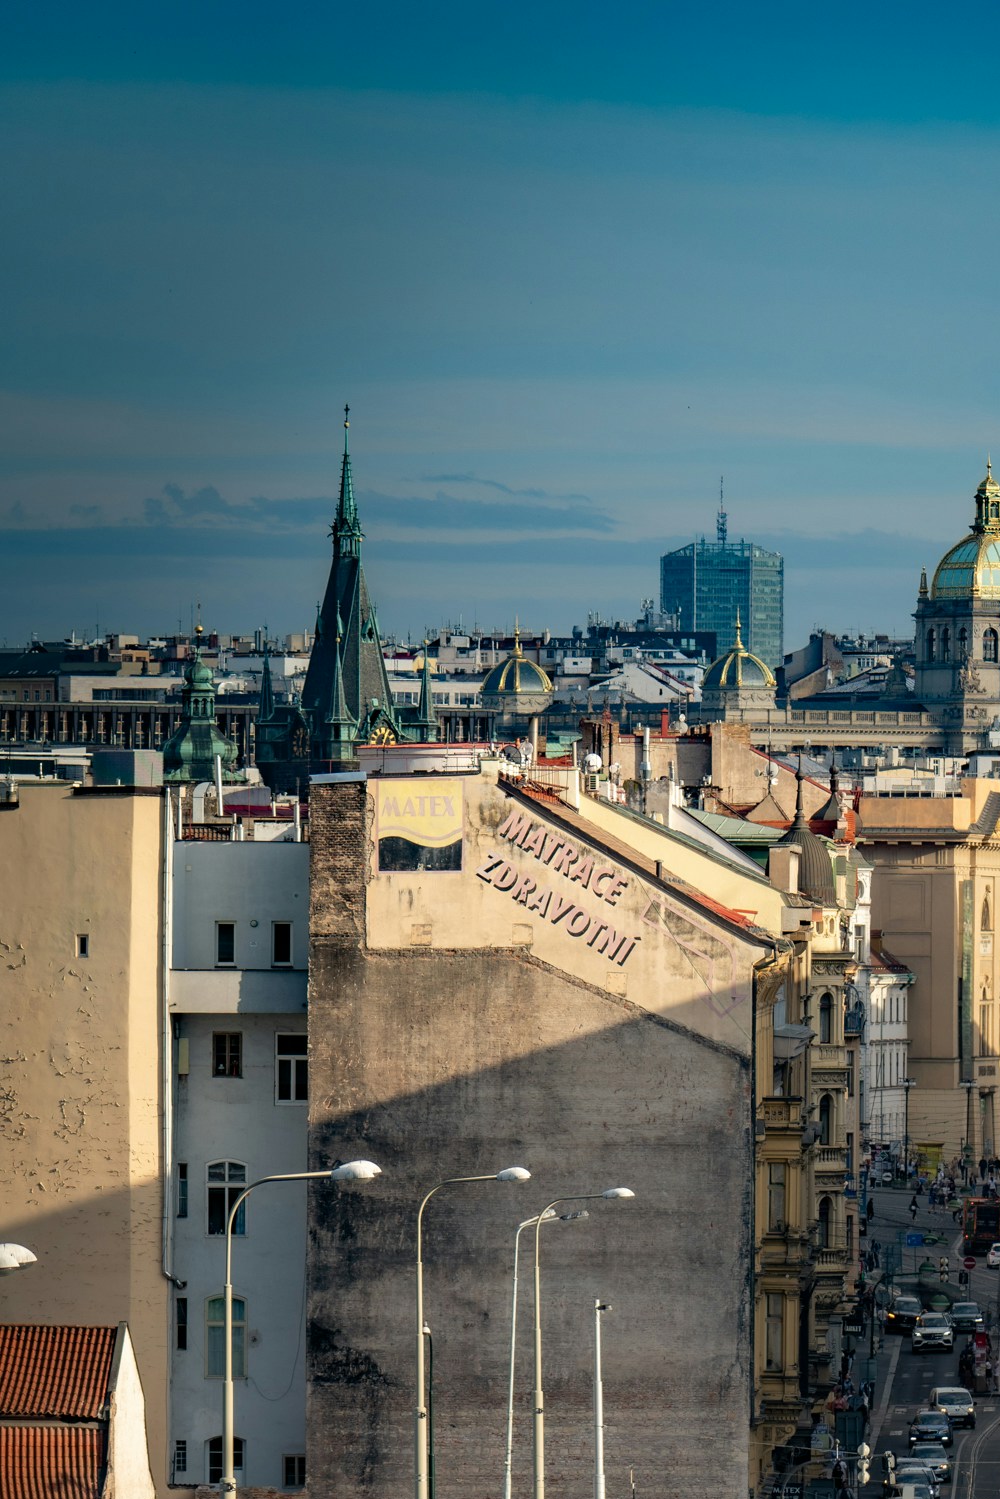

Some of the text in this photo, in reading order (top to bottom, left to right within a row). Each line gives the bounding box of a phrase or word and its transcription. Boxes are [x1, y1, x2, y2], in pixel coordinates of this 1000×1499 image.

[381, 794, 455, 818] MATEX
[498, 810, 628, 906] MATRACE
[475, 850, 642, 966] ZDRAVOTNÍ
